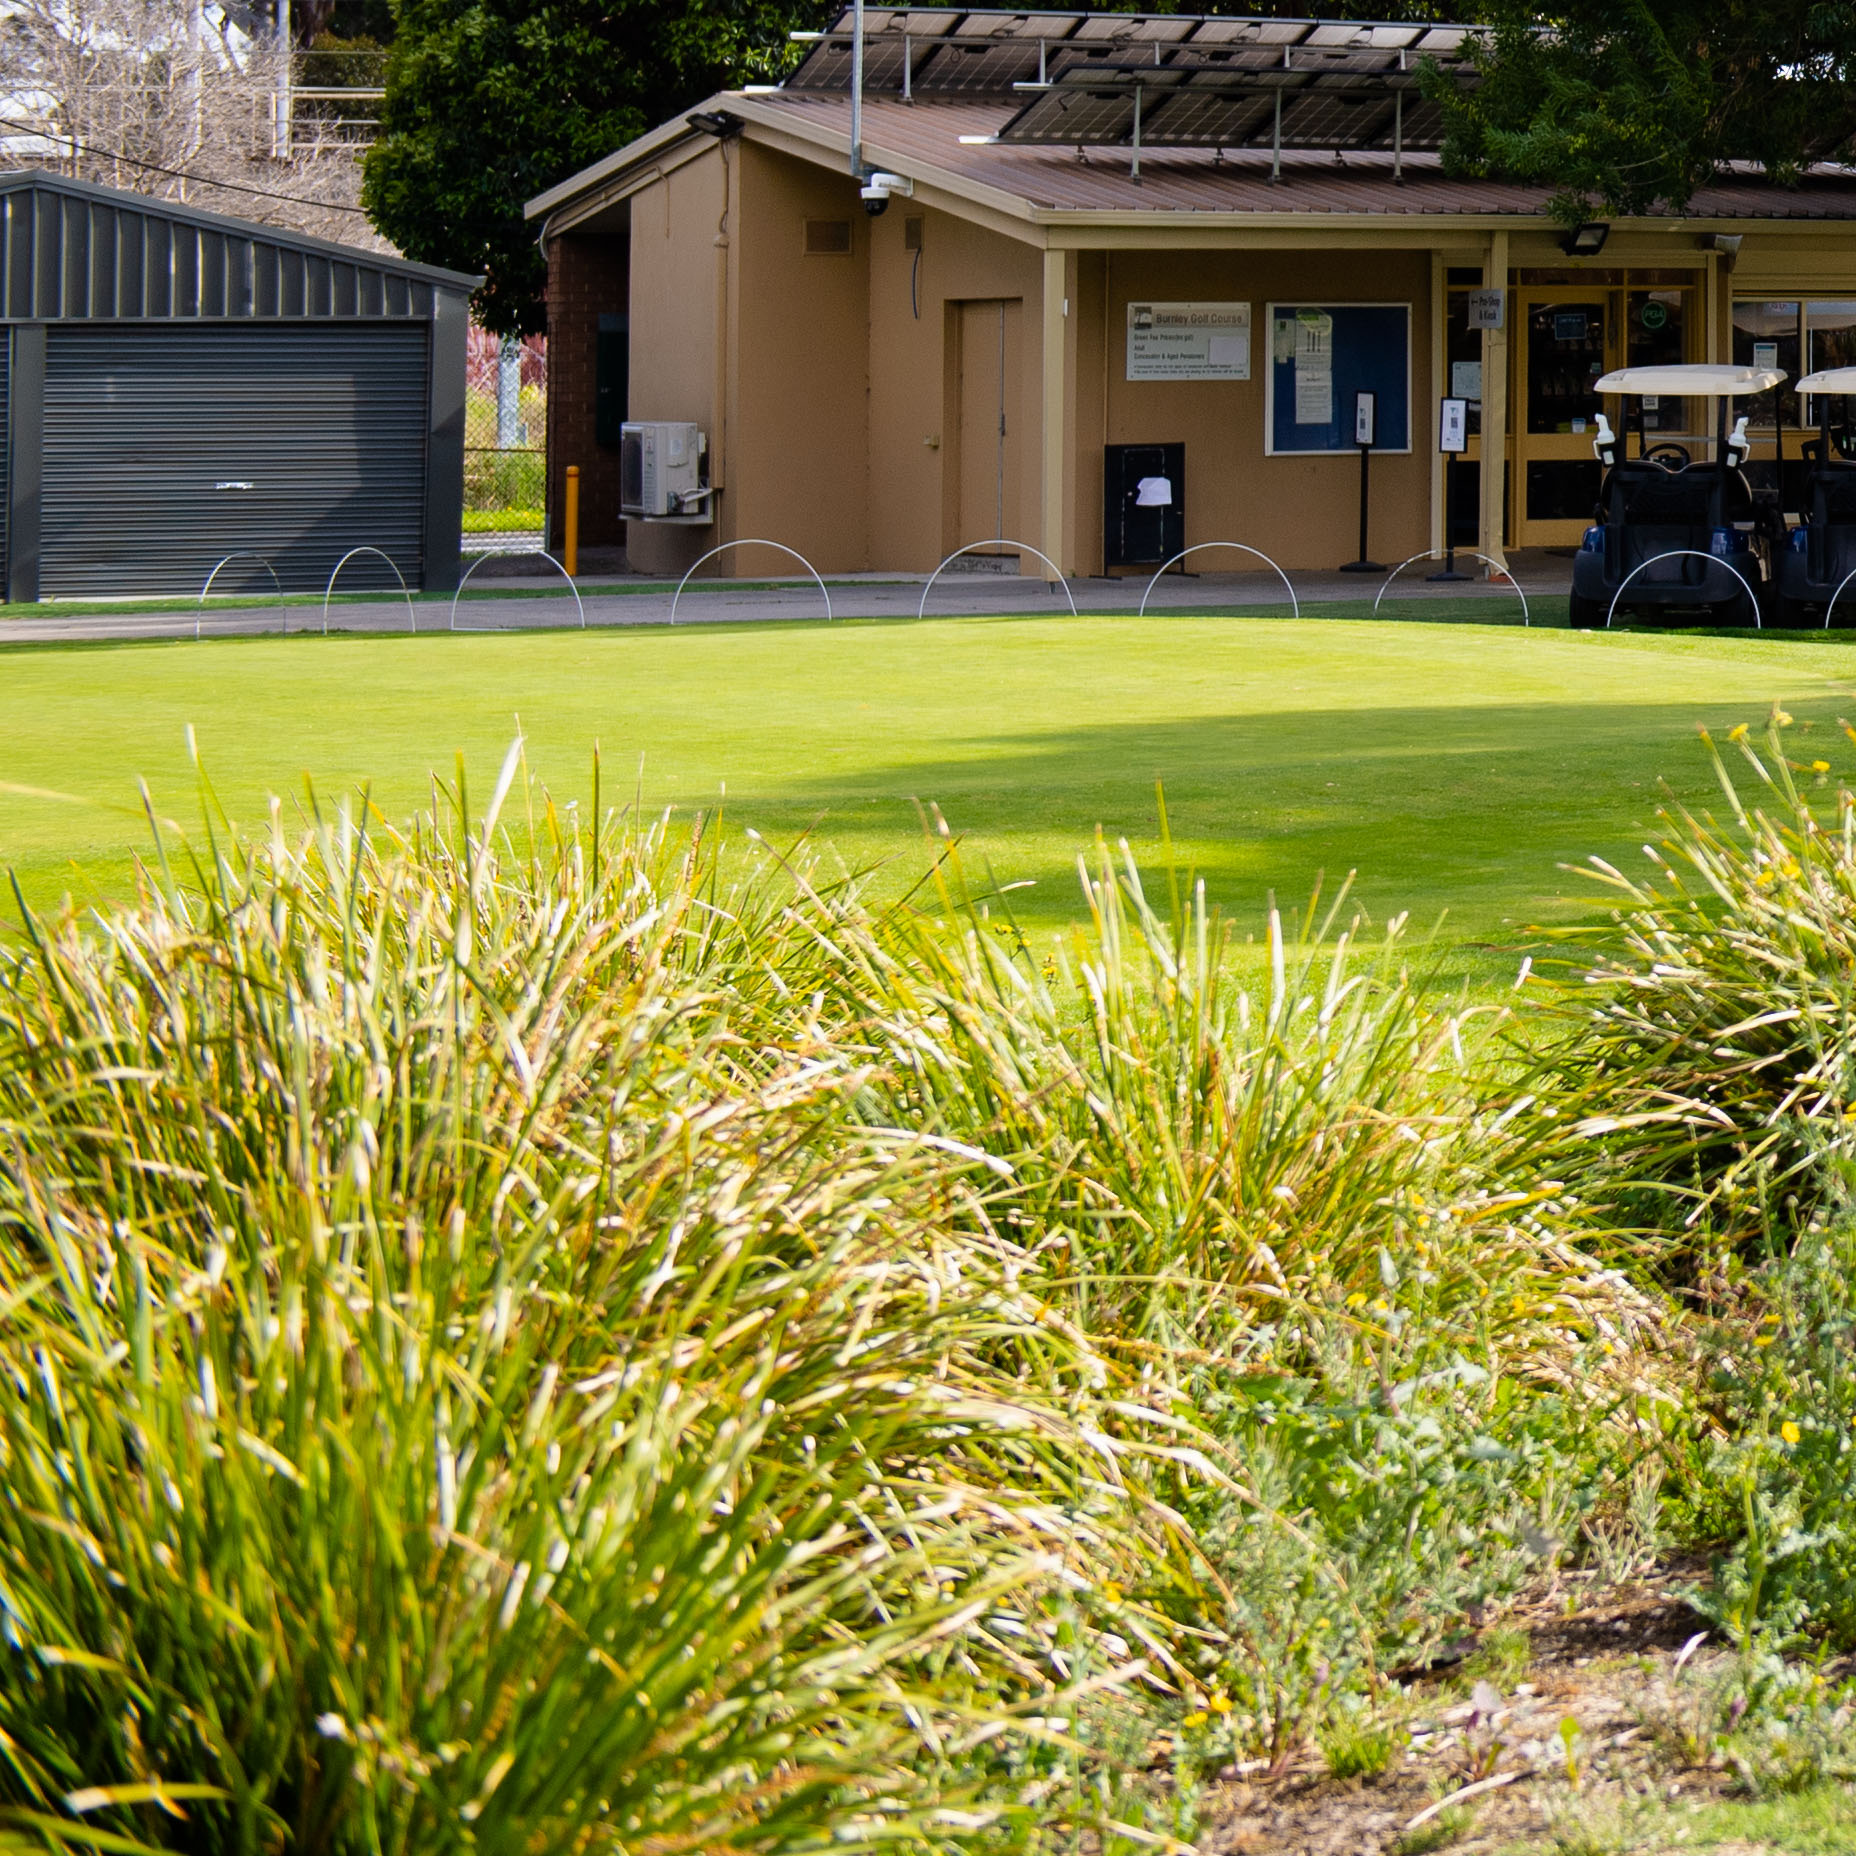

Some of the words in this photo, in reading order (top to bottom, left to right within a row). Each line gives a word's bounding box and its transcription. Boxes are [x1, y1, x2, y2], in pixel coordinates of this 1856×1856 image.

[1156, 313, 1188, 327] Burnley
[1190, 313, 1209, 324] Golf
[1211, 313, 1242, 324] Course
